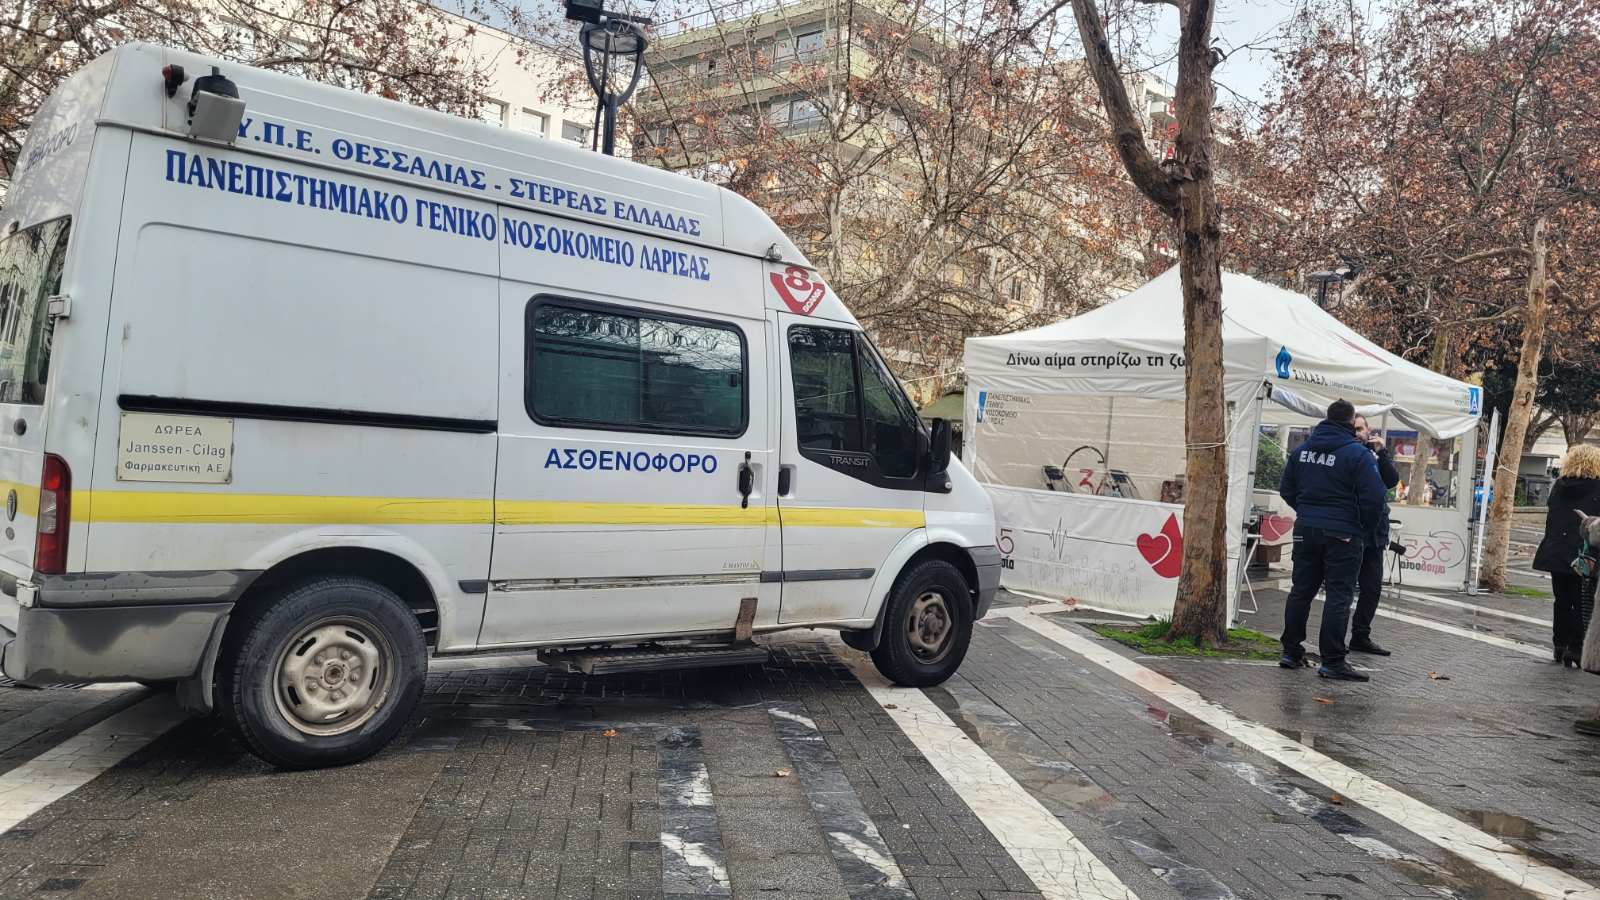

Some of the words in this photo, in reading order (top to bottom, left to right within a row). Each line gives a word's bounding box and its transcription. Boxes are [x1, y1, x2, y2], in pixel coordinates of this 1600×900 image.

[332, 138, 487, 189] ΘΕΣΣΑΛΙΑΣ
[510, 178, 607, 216] ΣΤΕΡΕΑΣ
[614, 202, 702, 237] ΕΛΛΑΔΑΣ
[165, 149, 408, 224] ΠΑΝΕΠΙΣΤΗΜΙΑΚΟ
[415, 198, 497, 241] ΓΕΝΙΚΟ
[503, 217, 634, 267] ΝΟΣΟΚΟΜΕΙΟ
[640, 245, 711, 282] ΛΑΡΙΣΑΣ
[1006, 352, 1040, 366] Δίνω
[1044, 352, 1076, 369] αίμα
[1080, 352, 1141, 370] στηρίζω
[1146, 357, 1164, 366] τη
[1169, 353, 1186, 370] ζω
[155, 425, 202, 436] ΔΩΡΕΑ
[126, 441, 182, 454] Janssen
[192, 443, 226, 458] Cilag
[544, 448, 718, 474] ΑΣΘΕΝΟΦΟΡΟ
[830, 455, 870, 466] TRANSIT
[1299, 450, 1336, 467] ΕΚΑΒ
[206, 463, 225, 473] Α.Ε.
